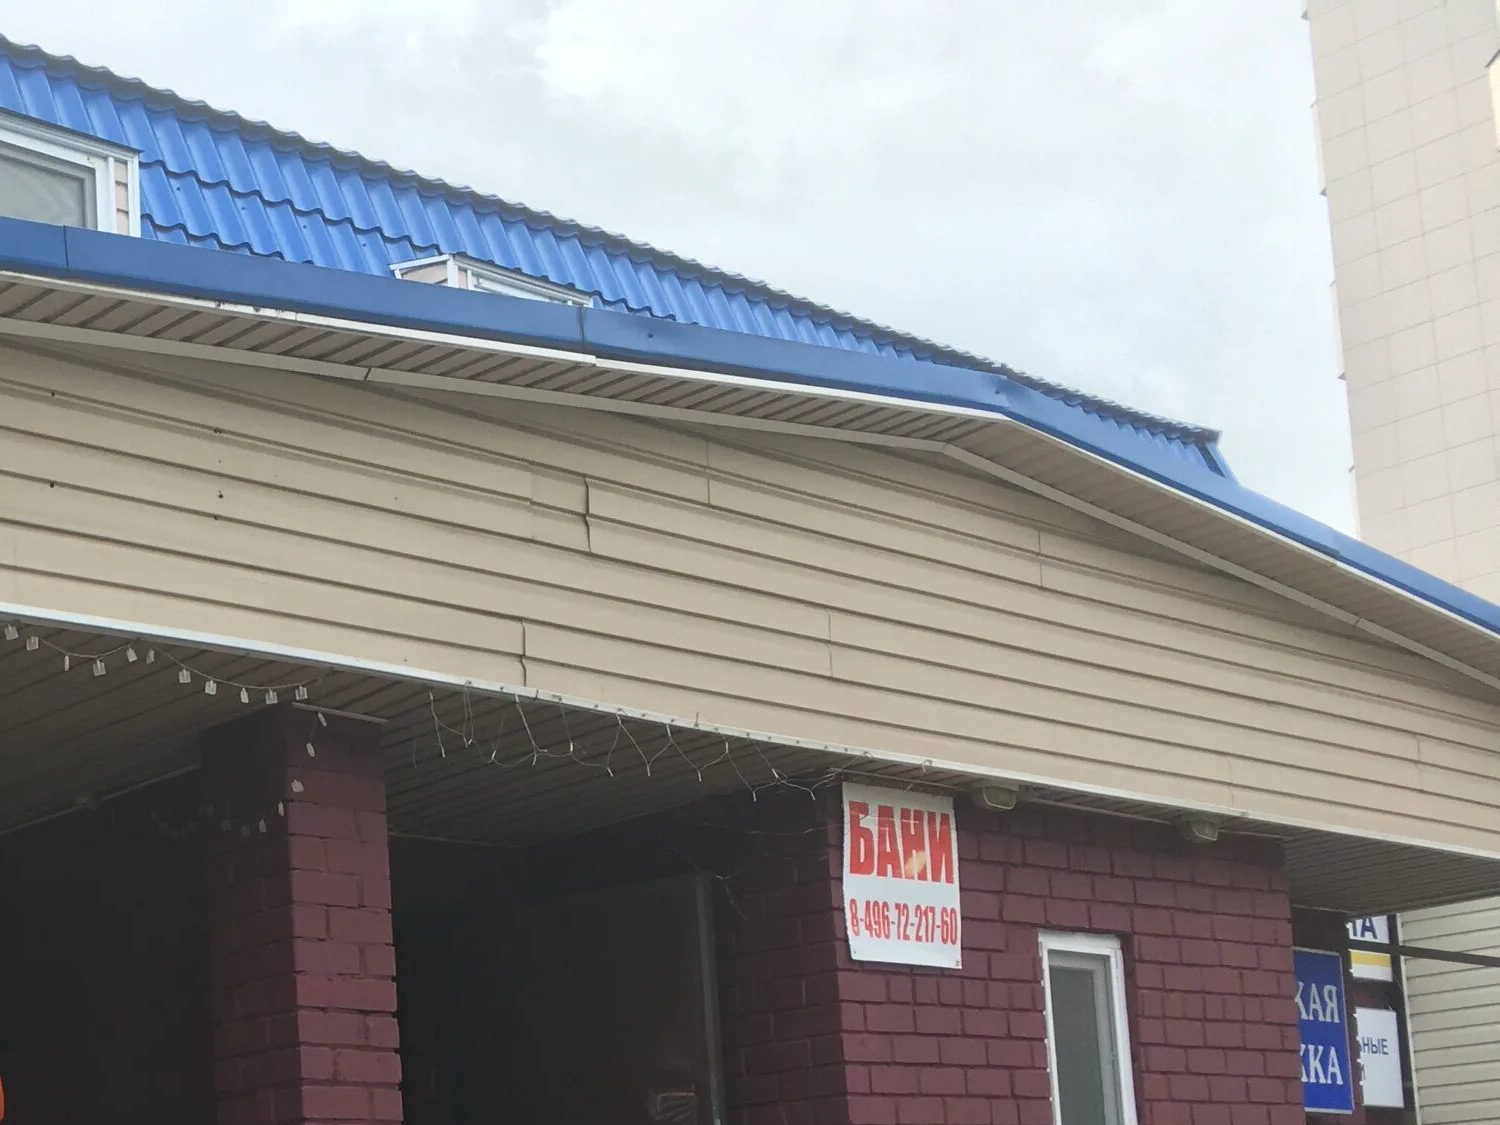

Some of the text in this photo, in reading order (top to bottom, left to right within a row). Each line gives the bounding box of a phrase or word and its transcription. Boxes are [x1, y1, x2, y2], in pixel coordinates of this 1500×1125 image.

[848, 801, 954, 884] БАНИ
[849, 898, 958, 945] 8-496-72-217-60
[1360, 1037, 1390, 1056] НЫЕ
